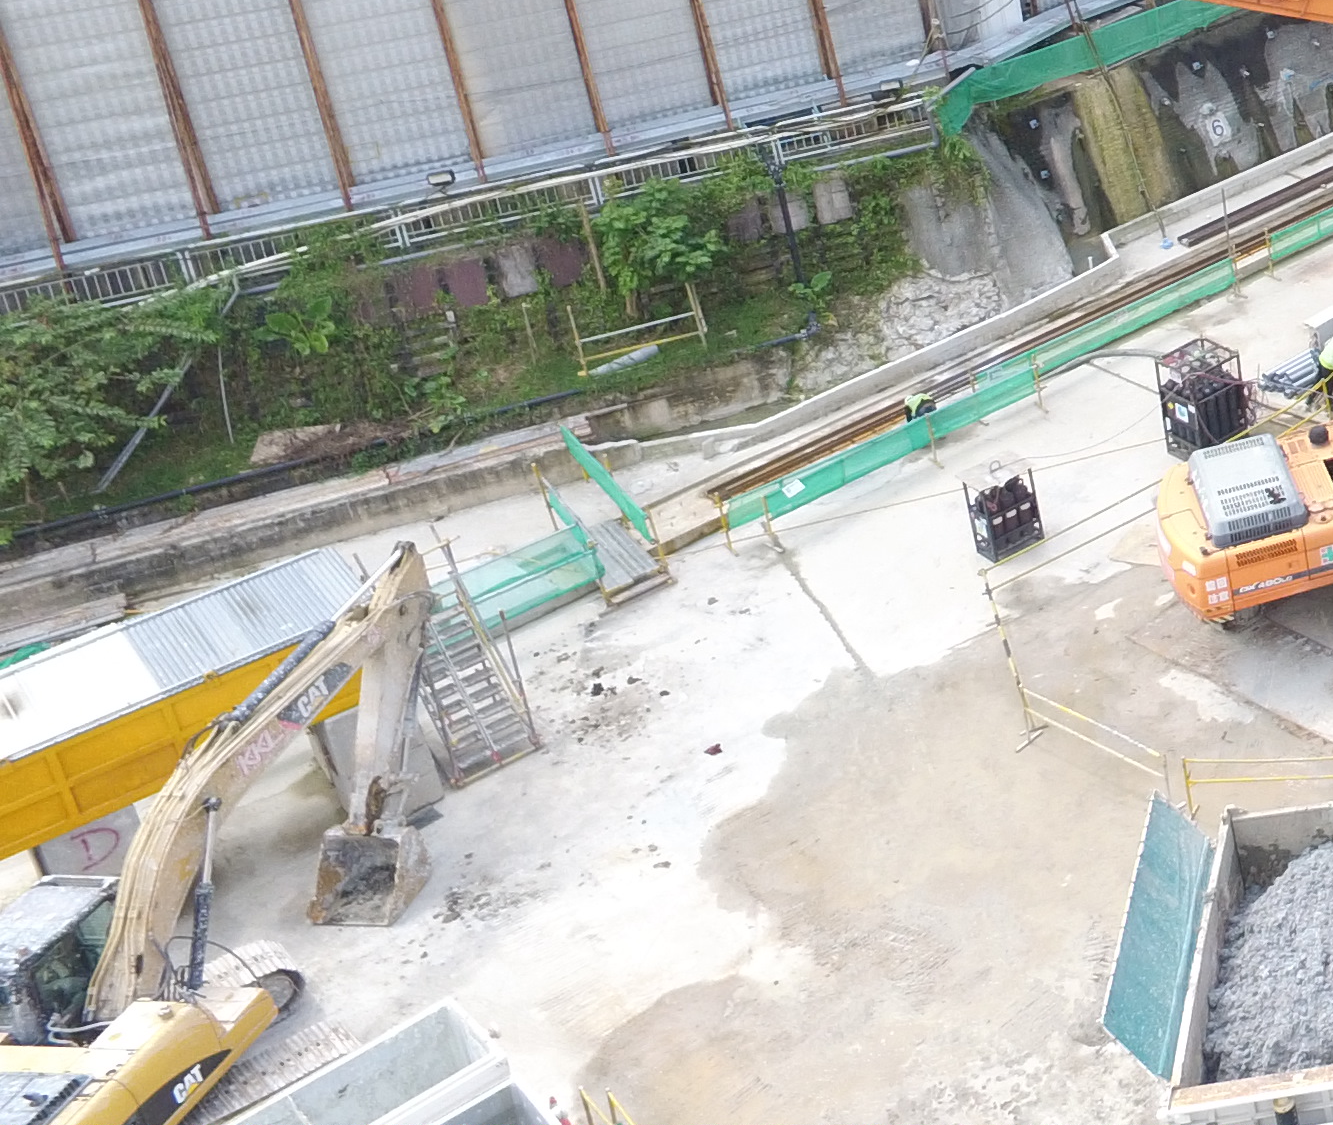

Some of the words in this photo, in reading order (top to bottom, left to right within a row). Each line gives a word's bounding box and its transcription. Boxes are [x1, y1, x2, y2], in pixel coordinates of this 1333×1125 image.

[1212, 119, 1224, 136] 6
[297, 674, 329, 718] CAT
[70, 827, 119, 872] D
[173, 1063, 204, 1104] CAT
